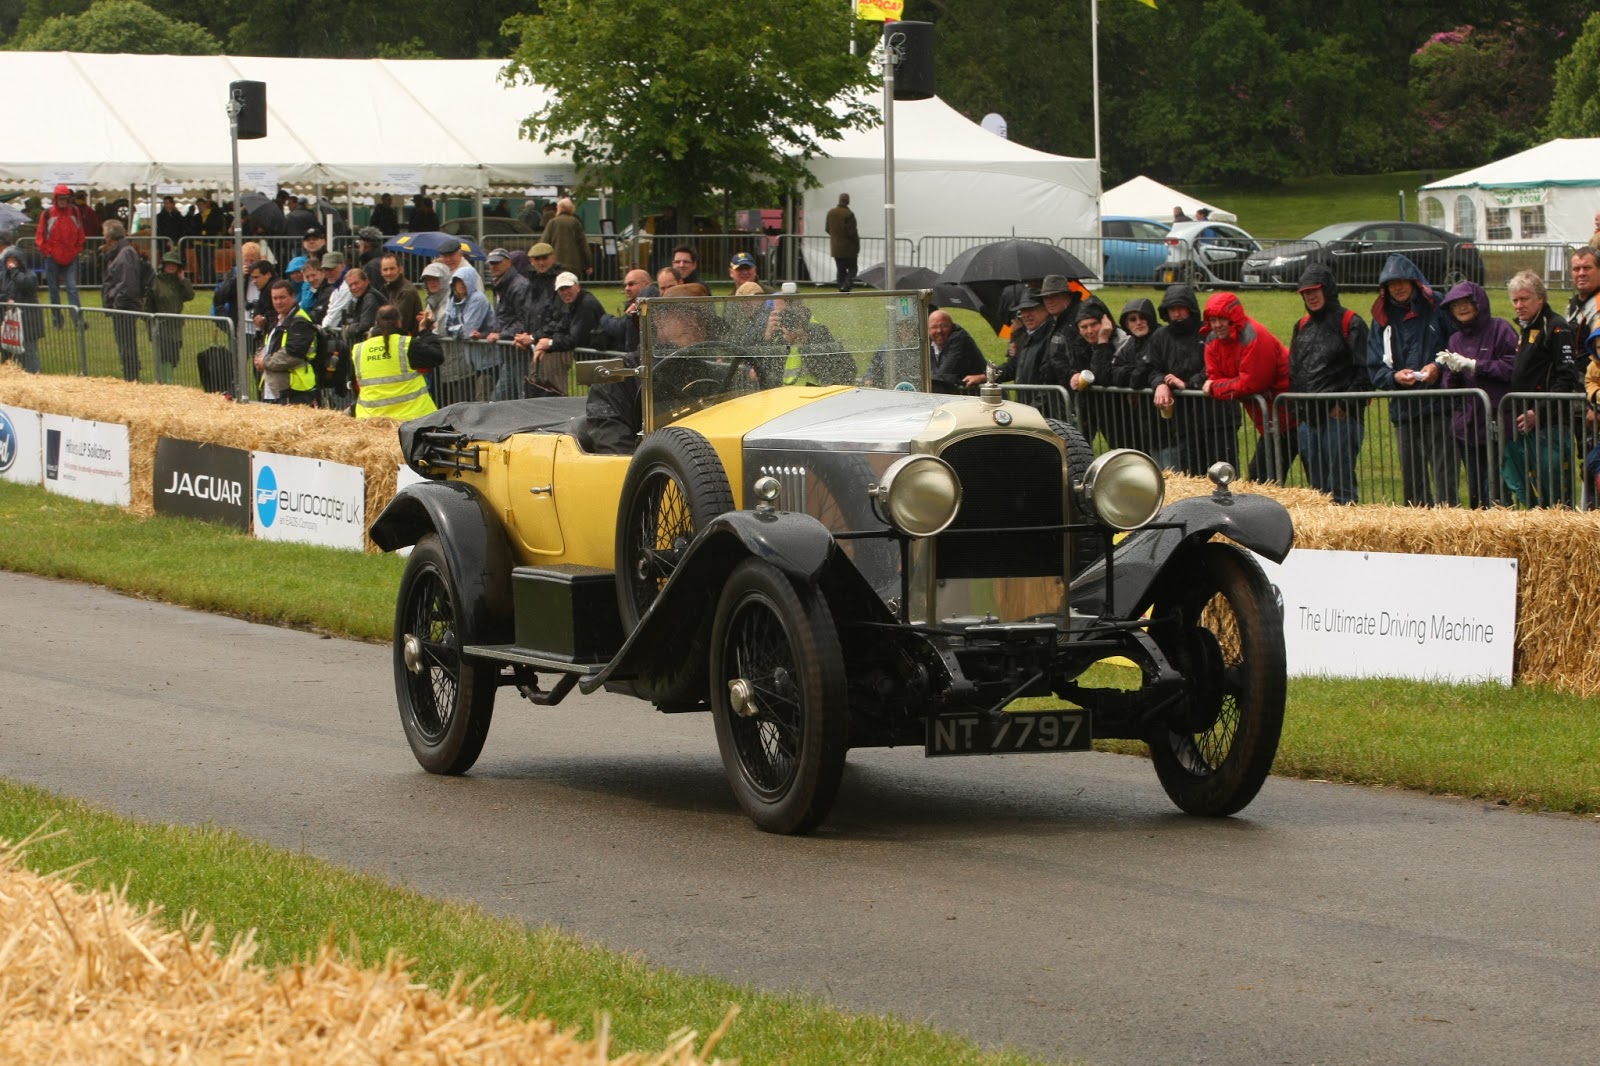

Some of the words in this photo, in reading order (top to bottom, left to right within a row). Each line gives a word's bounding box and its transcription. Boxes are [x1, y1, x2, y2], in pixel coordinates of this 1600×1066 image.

[1519, 194, 1541, 204] ROOM
[367, 352, 392, 362] PRESS
[164, 471, 242, 506] JAGUAR
[279, 490, 345, 526] eurocopter
[346, 495, 360, 526] uk
[1299, 606, 1321, 632] The
[1324, 607, 1376, 636] Ultimate
[1379, 611, 1426, 645] Driving
[1430, 614, 1494, 644] Machine
[934, 717, 979, 751] NT
[990, 715, 1083, 749] 7797
